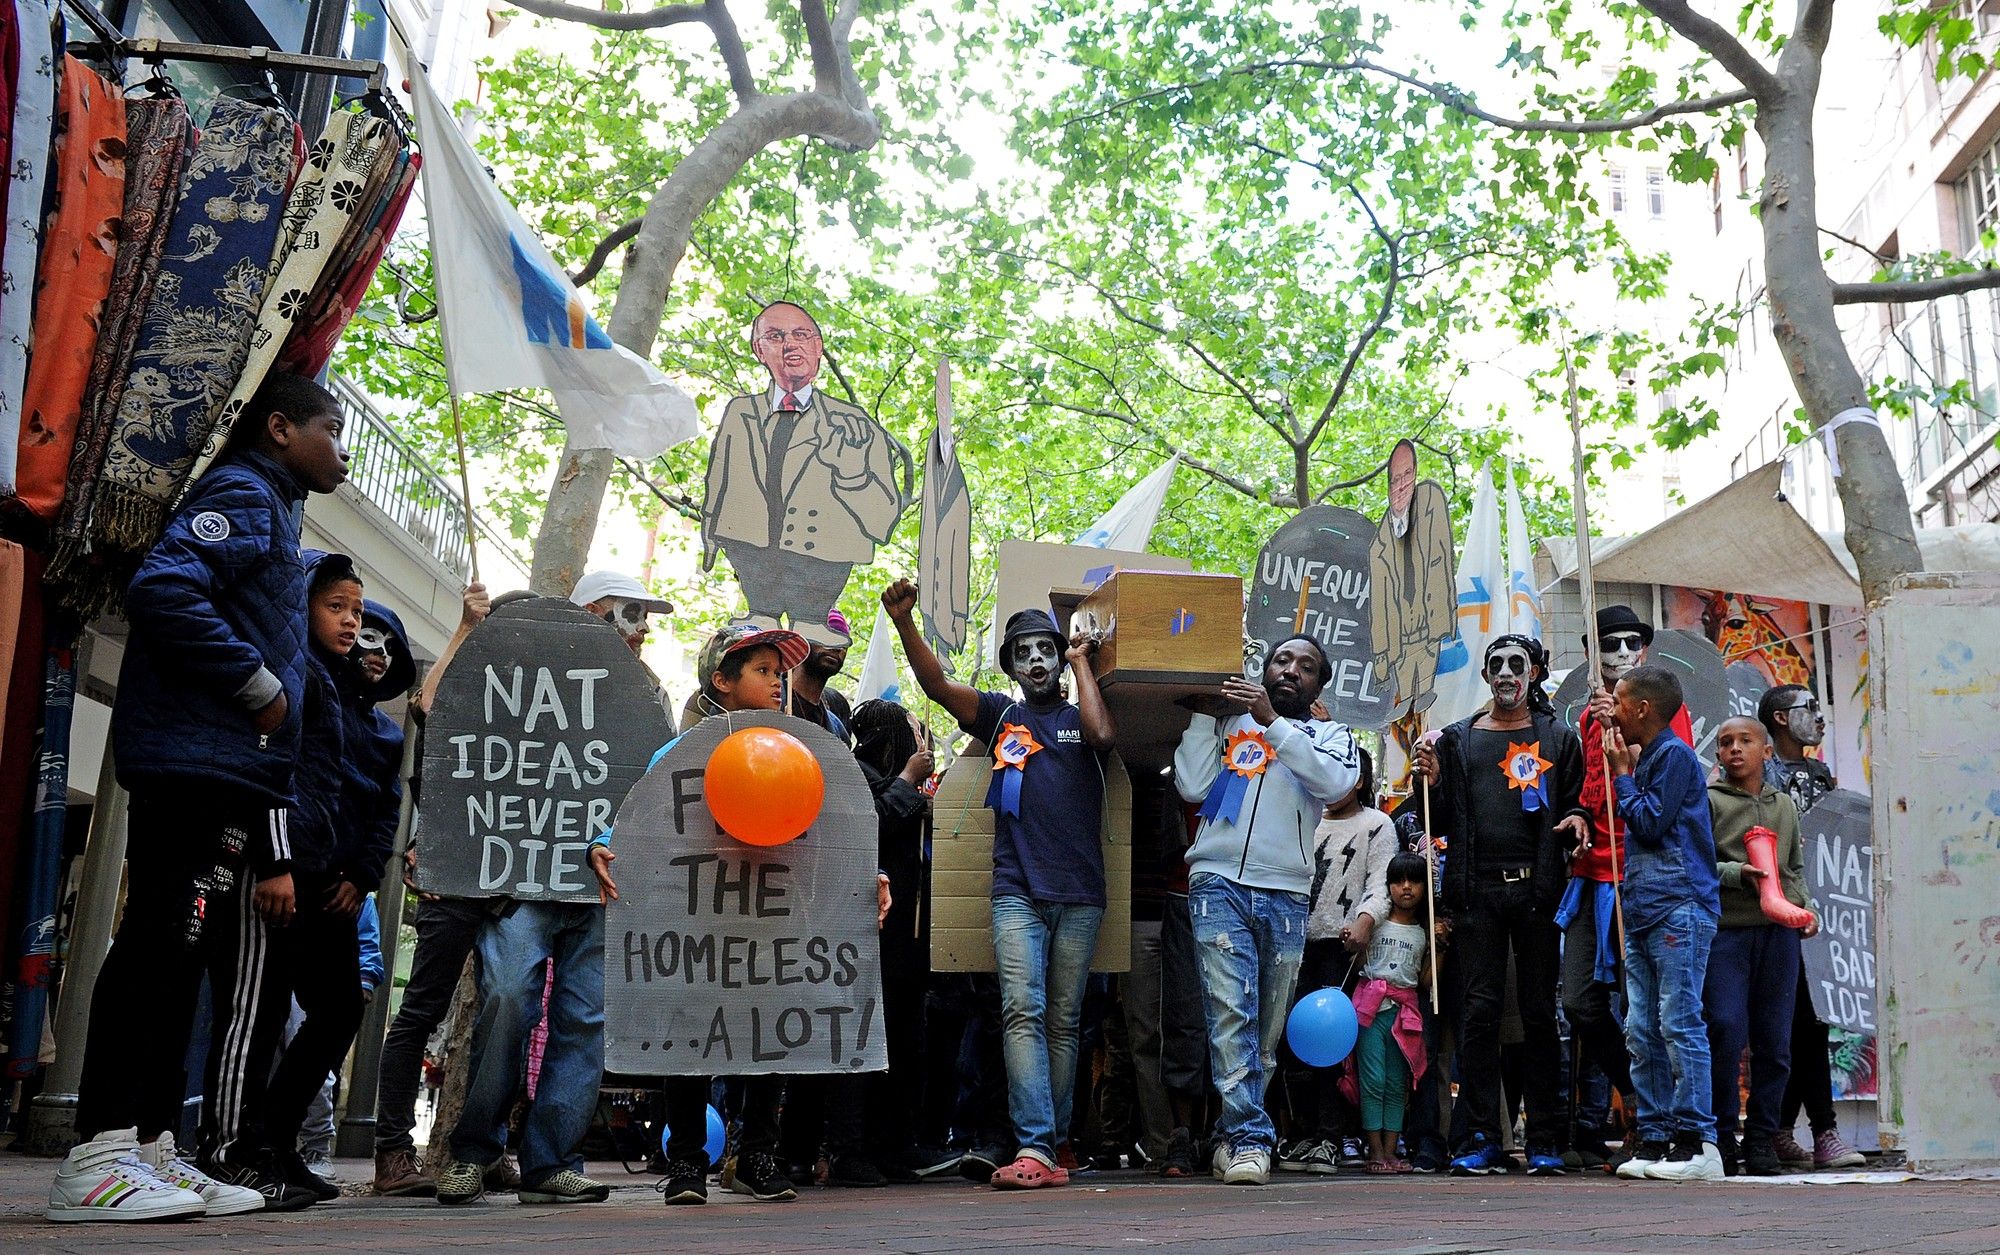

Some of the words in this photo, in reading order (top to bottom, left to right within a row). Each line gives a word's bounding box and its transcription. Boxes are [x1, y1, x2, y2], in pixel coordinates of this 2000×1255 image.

[484, 664, 610, 733] NAT
[448, 734, 610, 790] IDEAS
[466, 790, 612, 840] NEVER
[479, 834, 589, 892] DIE
[669, 853, 791, 918] THE
[624, 930, 860, 989] HOMELESS
[1381, 937, 1396, 947] PART
[1398, 940, 1414, 951] TIME
[1829, 939, 1876, 989] BAD
[751, 998, 876, 1067] LOT!
